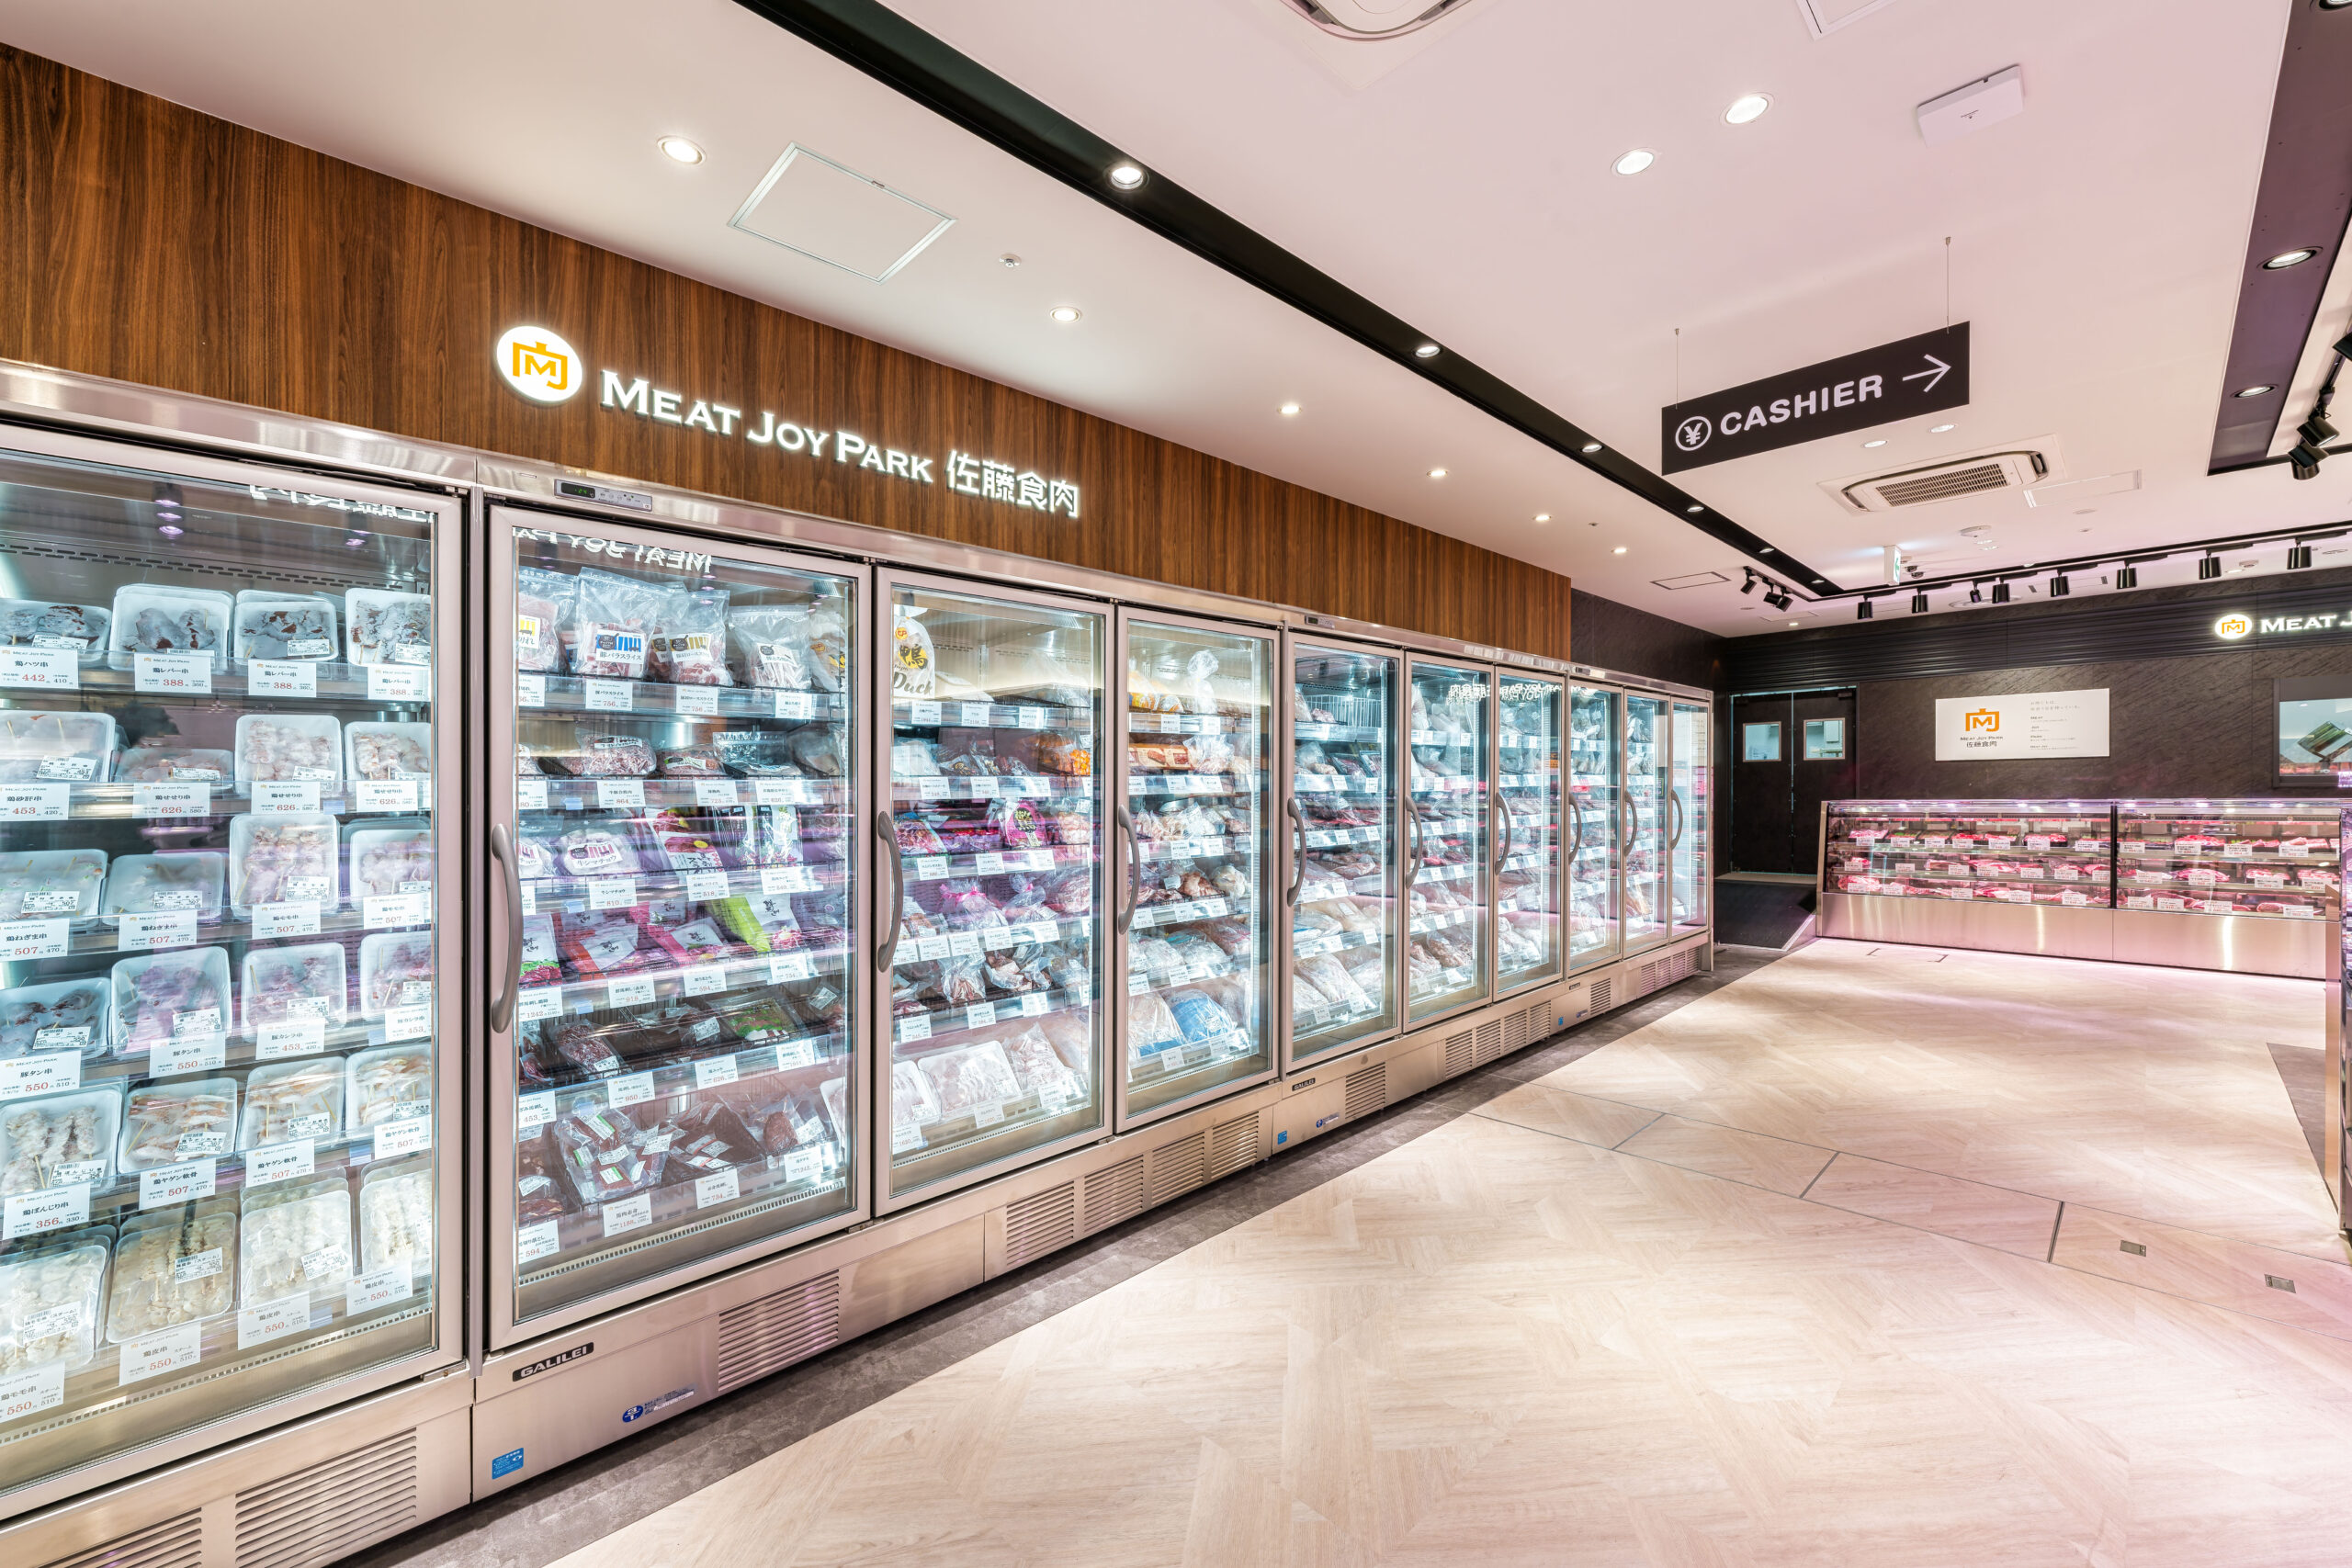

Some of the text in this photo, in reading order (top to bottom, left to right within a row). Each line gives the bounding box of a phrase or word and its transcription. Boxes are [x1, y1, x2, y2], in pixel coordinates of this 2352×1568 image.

[1720, 375, 1883, 435] CASHIER
[601, 369, 1080, 518] MEAT JOY PARK 佐藤食肉
[2260, 615, 2337, 633] MEAT
[600, 651, 641, 660] 豚バラスライス
[22, 673, 46, 682] 442
[894, 671, 933, 694] Duck
[163, 679, 184, 687] 388
[149, 936, 171, 944] 507
[15, 947, 39, 956] 507
[408, 1026, 424, 1034] 453
[282, 1043, 301, 1052] 453
[177, 1060, 198, 1070] 550
[25, 1081, 49, 1092] 550
[524, 1114, 538, 1122] 453
[397, 1139, 413, 1148] 507
[271, 1169, 290, 1179] 507
[167, 1186, 189, 1197] 507
[711, 1193, 723, 1201] 734
[36, 1215, 80, 1229] 356 330
[526, 1248, 540, 1258] 594
[370, 1290, 389, 1302] 550
[265, 1322, 285, 1334] 550
[149, 1358, 172, 1371] 550
[520, 1346, 588, 1379] GALILEI
[6, 1397, 55, 1416] 550 510
